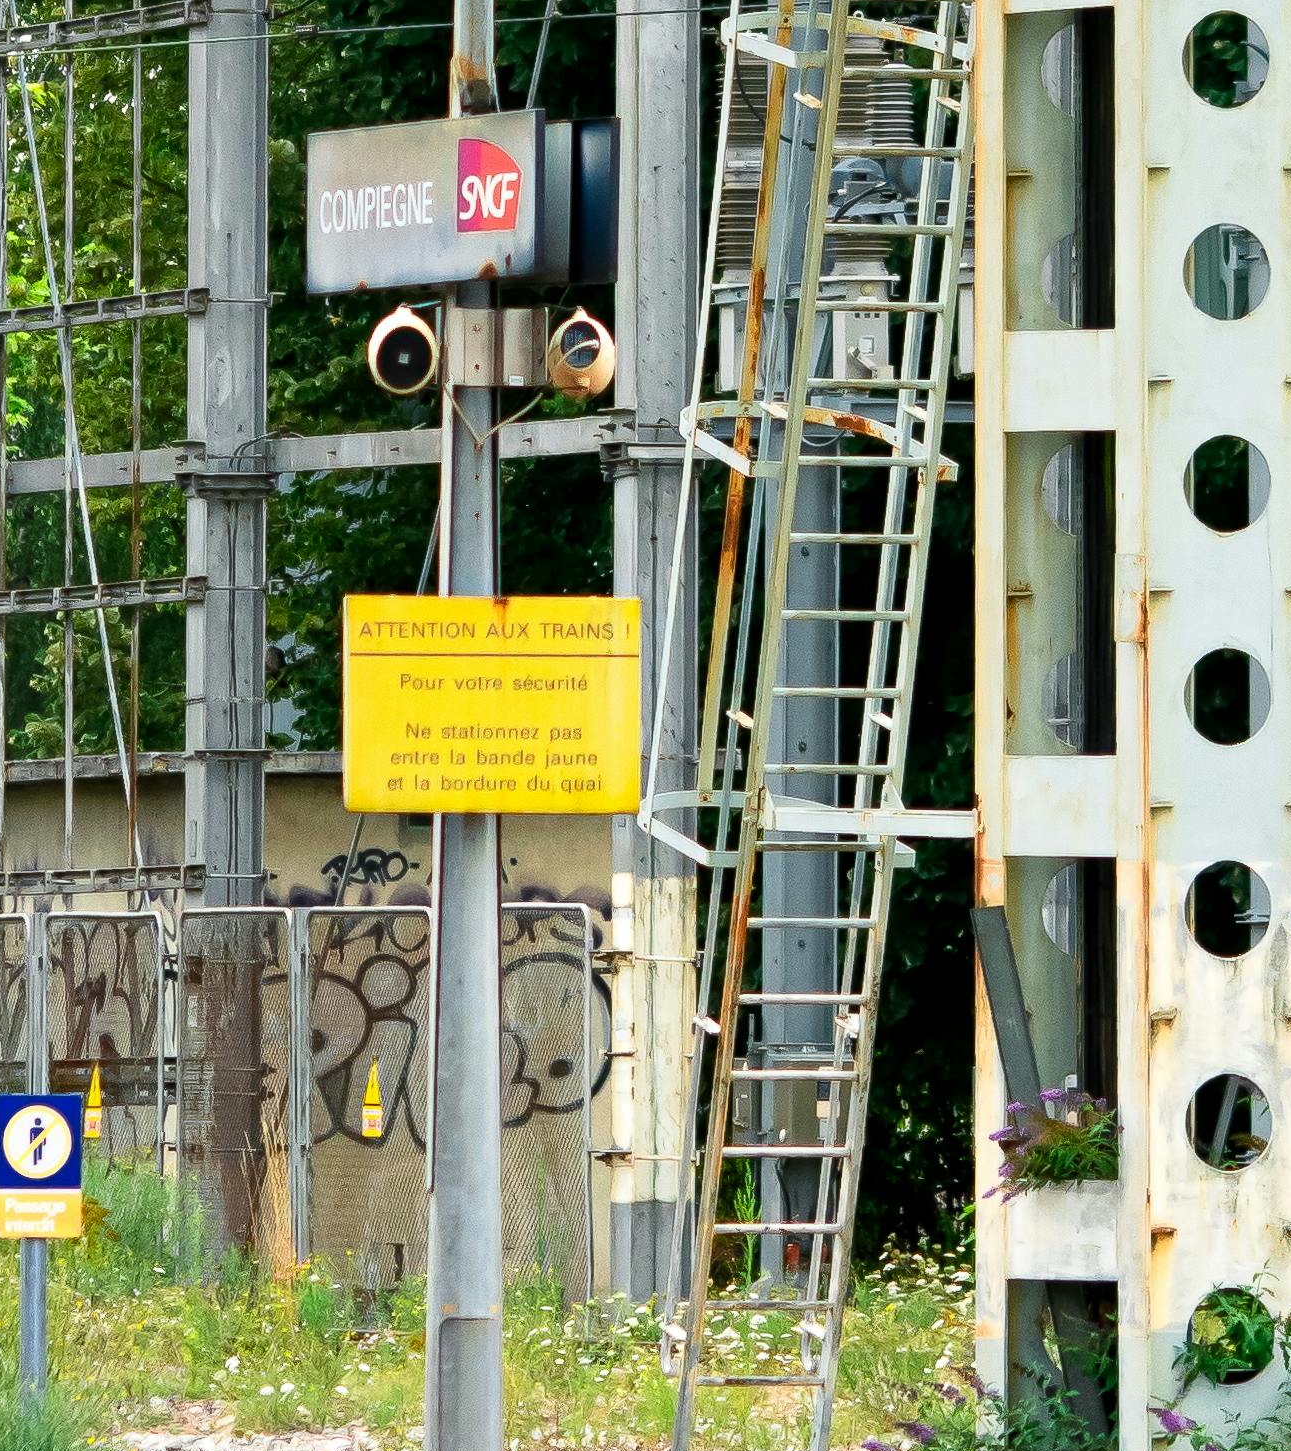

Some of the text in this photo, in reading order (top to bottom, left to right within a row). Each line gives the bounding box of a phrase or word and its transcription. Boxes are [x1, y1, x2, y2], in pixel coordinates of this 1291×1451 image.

[459, 172, 519, 220] SNCF
[319, 181, 434, 234] COMPIEGNE
[358, 622, 476, 640] ATTENTION
[486, 622, 530, 640] AUX
[539, 622, 614, 640] TRAINS
[399, 673, 589, 691] Pour votre sécurité
[405, 722, 583, 744] Ne stationnez pas
[390, 749, 598, 768] entre la bande jaune
[387, 774, 602, 794] et la bordure du quai
[5, 1197, 67, 1217] Passage
[5, 1217, 55, 1232] interdit
